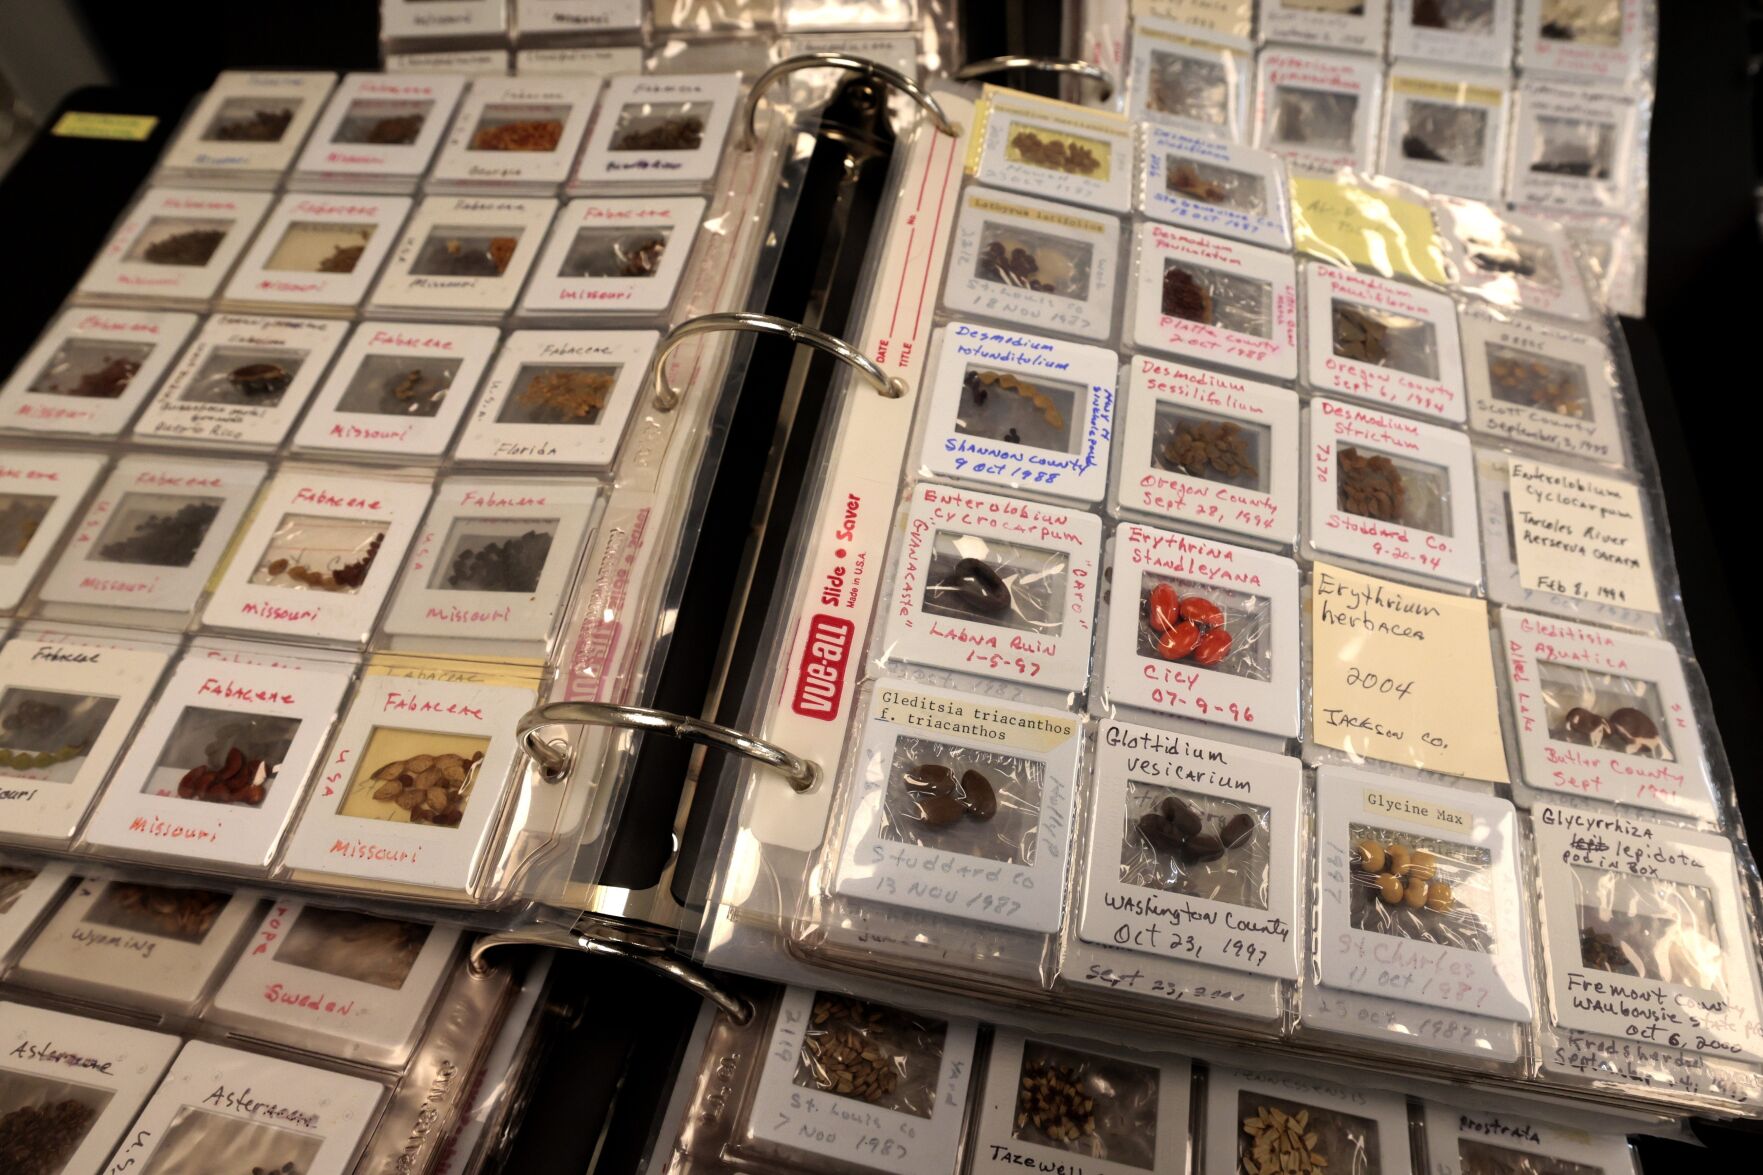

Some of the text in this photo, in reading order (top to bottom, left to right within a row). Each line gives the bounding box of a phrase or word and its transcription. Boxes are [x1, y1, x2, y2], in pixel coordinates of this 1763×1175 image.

[876, 339, 890, 364] DATE
[898, 342, 913, 368] TITLE
[954, 325, 1055, 353] Desmodium
[1142, 360, 1248, 393] Desmodium
[1009, 469, 1060, 484] 1988
[1143, 491, 1186, 511] Sept
[821, 493, 861, 607] Slide Saver
[846, 589, 858, 609] Made
[1537, 576, 1566, 593] Feb
[1346, 667, 1415, 699] 2004
[879, 707, 1007, 740] f. triacanthos
[882, 691, 1072, 737] Gleditsia triacanthos
[1366, 792, 1464, 825] Glycine Max
[1104, 891, 1290, 946] Washington County
[1113, 924, 1268, 967] Oct 23, 1997
[1568, 972, 1668, 1004] Fremont
[1626, 1026, 1669, 1041] Oct
